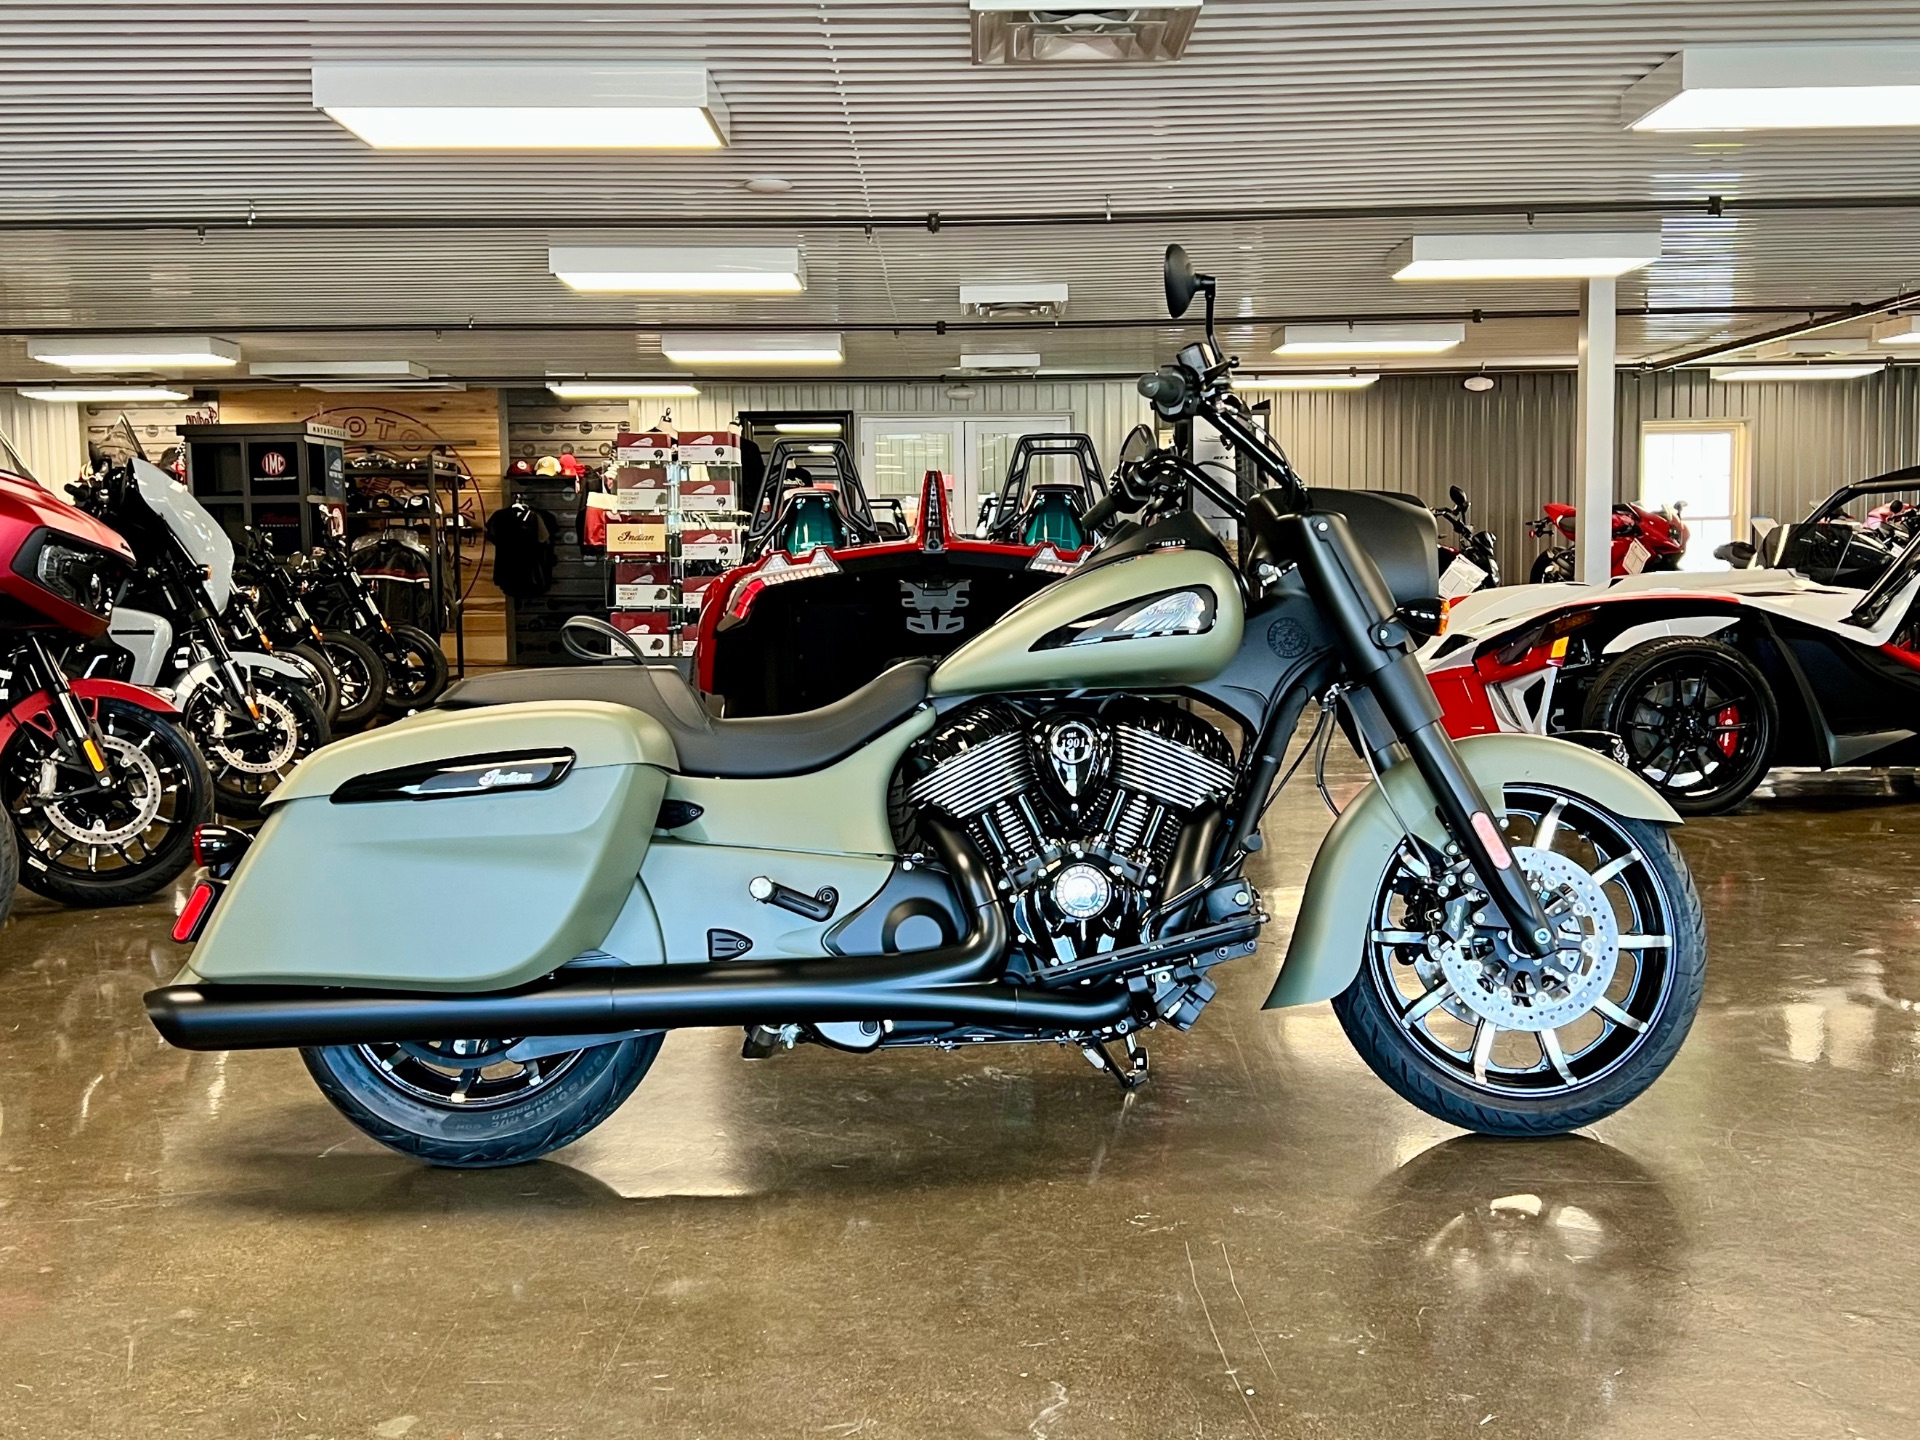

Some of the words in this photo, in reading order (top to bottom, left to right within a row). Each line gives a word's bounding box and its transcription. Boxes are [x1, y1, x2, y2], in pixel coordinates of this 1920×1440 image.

[264, 454, 285, 474] IMC
[617, 530, 655, 542] Indian
[1061, 737, 1085, 751] 1901
[478, 768, 533, 786] Indian
